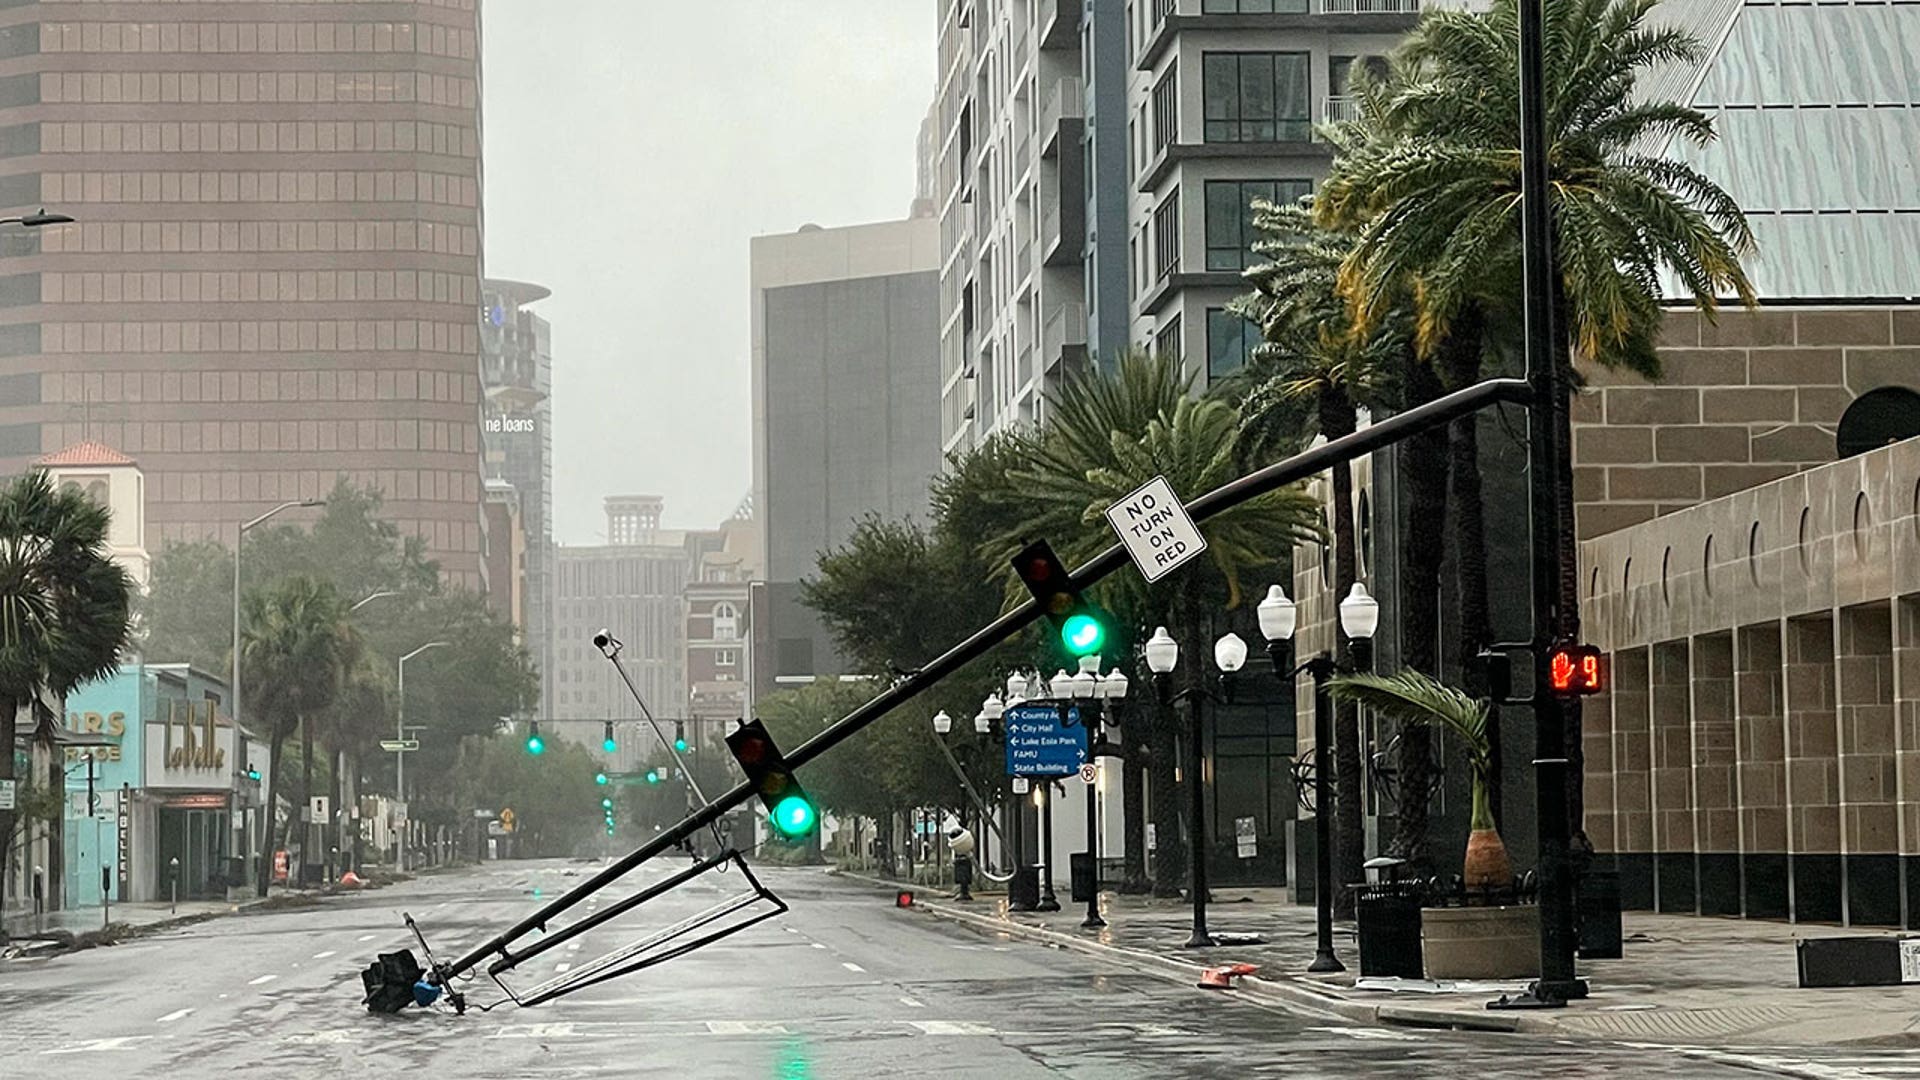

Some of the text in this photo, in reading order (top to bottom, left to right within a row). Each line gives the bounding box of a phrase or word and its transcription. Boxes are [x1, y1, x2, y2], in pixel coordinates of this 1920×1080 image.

[502, 414, 534, 432] loans
[1126, 494, 1156, 520] NO
[1130, 506, 1174, 538] TURN
[1150, 527, 1175, 548] ON
[1155, 541, 1187, 567] RED
[1583, 656, 1597, 687] 9
[1021, 711, 1049, 720] County
[1021, 724, 1053, 734] City Hall
[1013, 750, 1038, 759] FAMU
[1014, 763, 1068, 773] State Building
